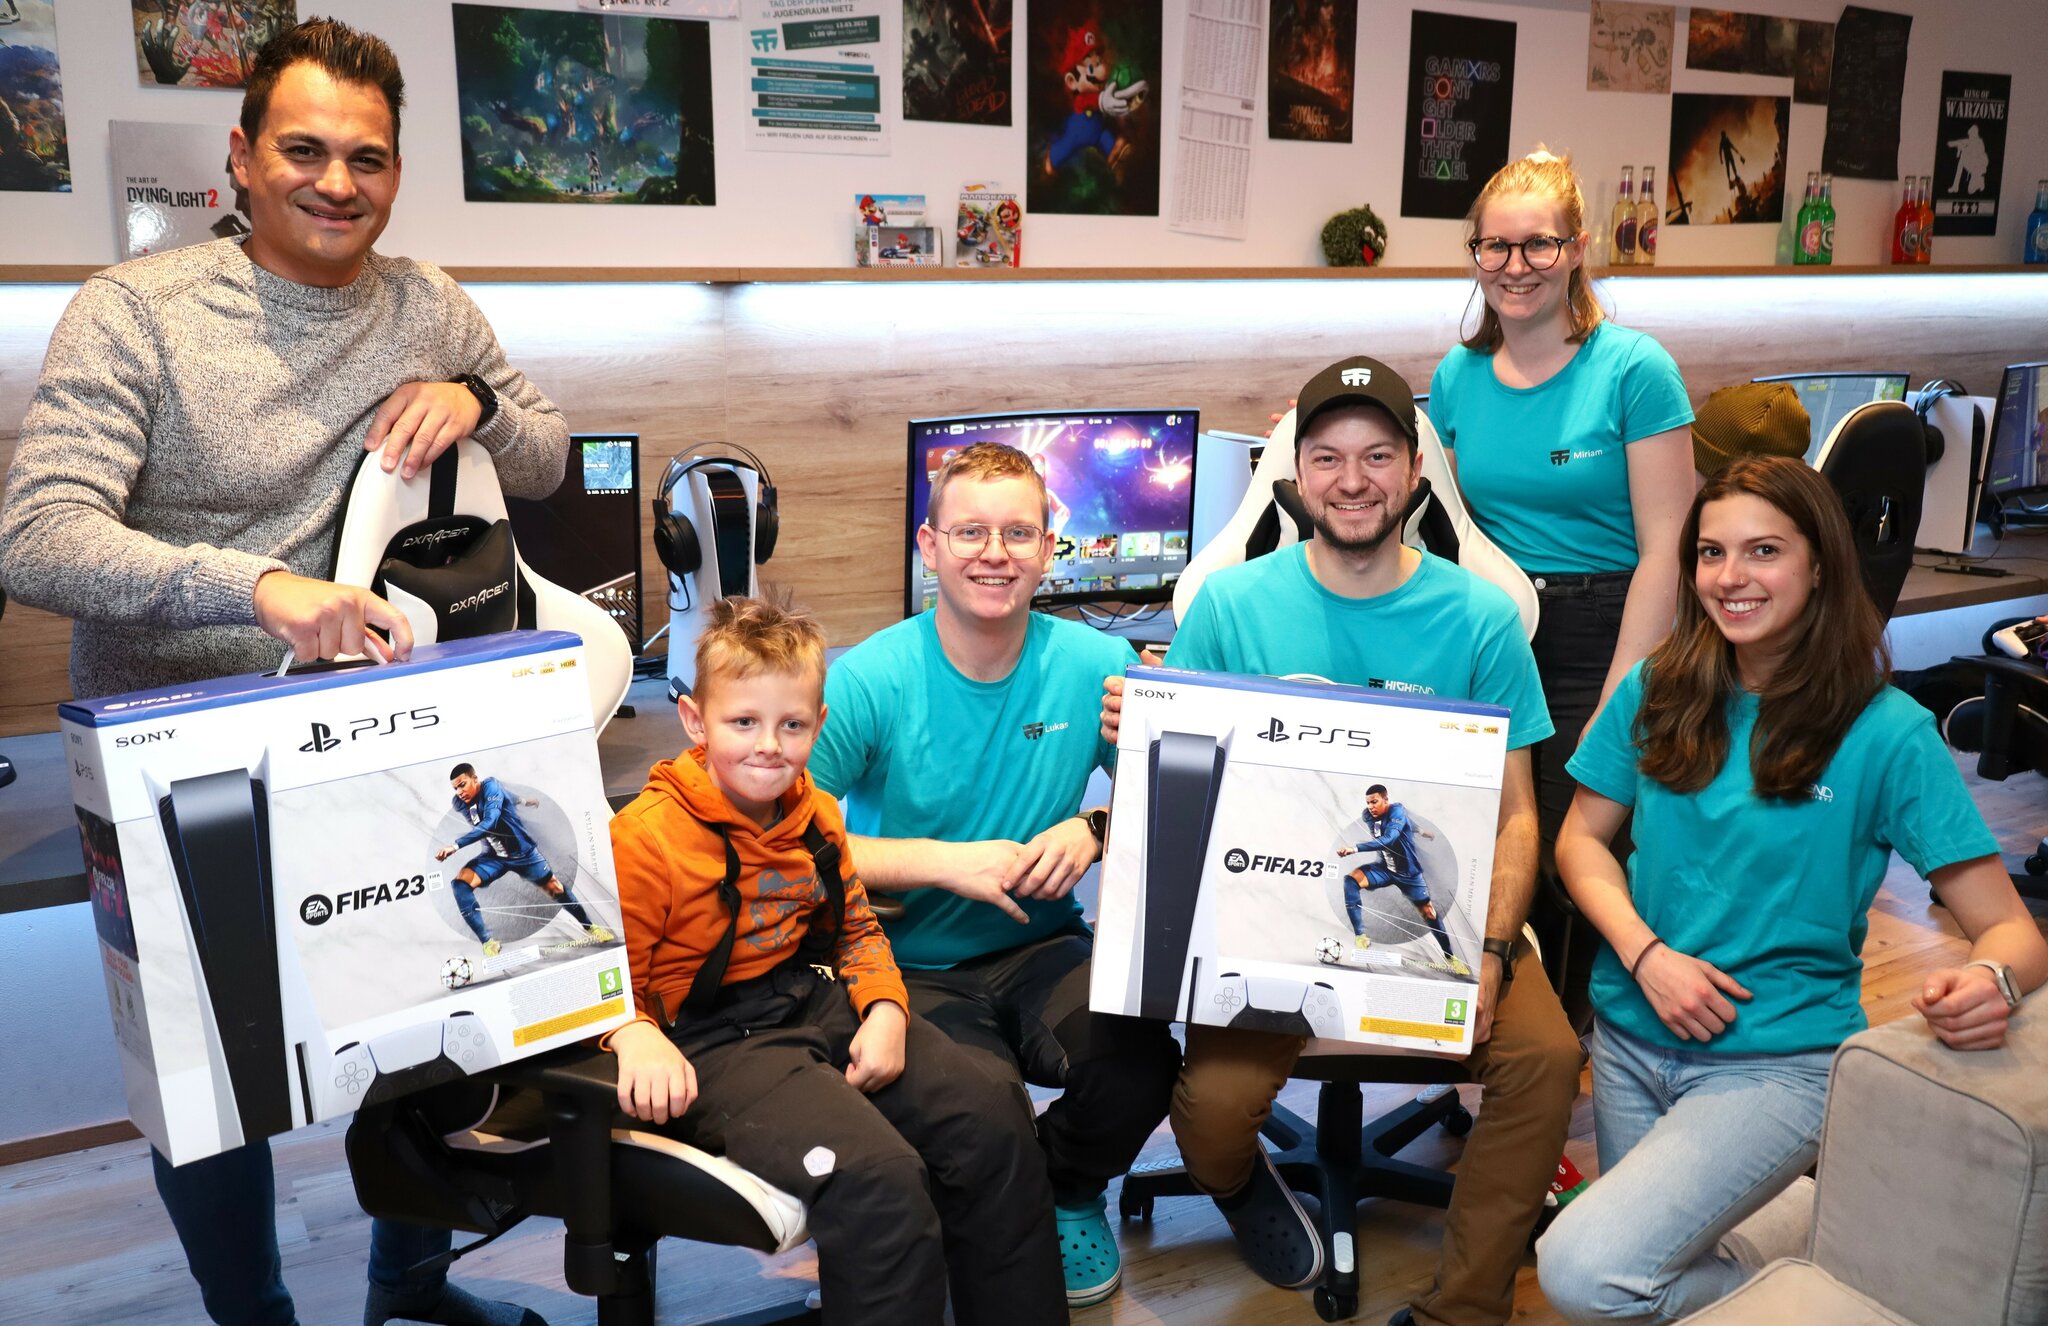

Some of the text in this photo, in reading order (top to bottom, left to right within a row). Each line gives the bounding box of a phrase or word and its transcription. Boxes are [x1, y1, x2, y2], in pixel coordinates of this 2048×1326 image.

[772, 8, 830, 18] JUGENDRAUM
[831, 4, 854, 13] RIETZ
[1964, 88, 1990, 99] KING OF
[1422, 98, 1456, 119] GET
[1946, 101, 2005, 120] WARZONE
[1421, 140, 1464, 160] THEY
[127, 187, 219, 208] DYING LIGHT 2
[1573, 449, 1603, 460] Miriam
[402, 527, 470, 550] DXRACER
[449, 581, 509, 613] DXRACER
[512, 667, 534, 678] 8K
[560, 660, 576, 668] HDR
[1134, 689, 1176, 700] SONY
[1385, 680, 1436, 696] HIGHEND
[350, 706, 440, 741] PS5
[1045, 721, 1069, 733] Lukas
[1440, 722, 1460, 731] 8K
[115, 729, 177, 748] SONY
[1298, 724, 1371, 748] PS5
[1227, 860, 1246, 868] SPORTS
[1228, 853, 1245, 863] EA
[1251, 855, 1325, 878] FIFA 23
[336, 874, 426, 915] FIFA 23
[305, 909, 329, 920] SPORTS
[306, 900, 328, 914] EA
[605, 971, 617, 991] 3
[1450, 1001, 1462, 1018] 3
